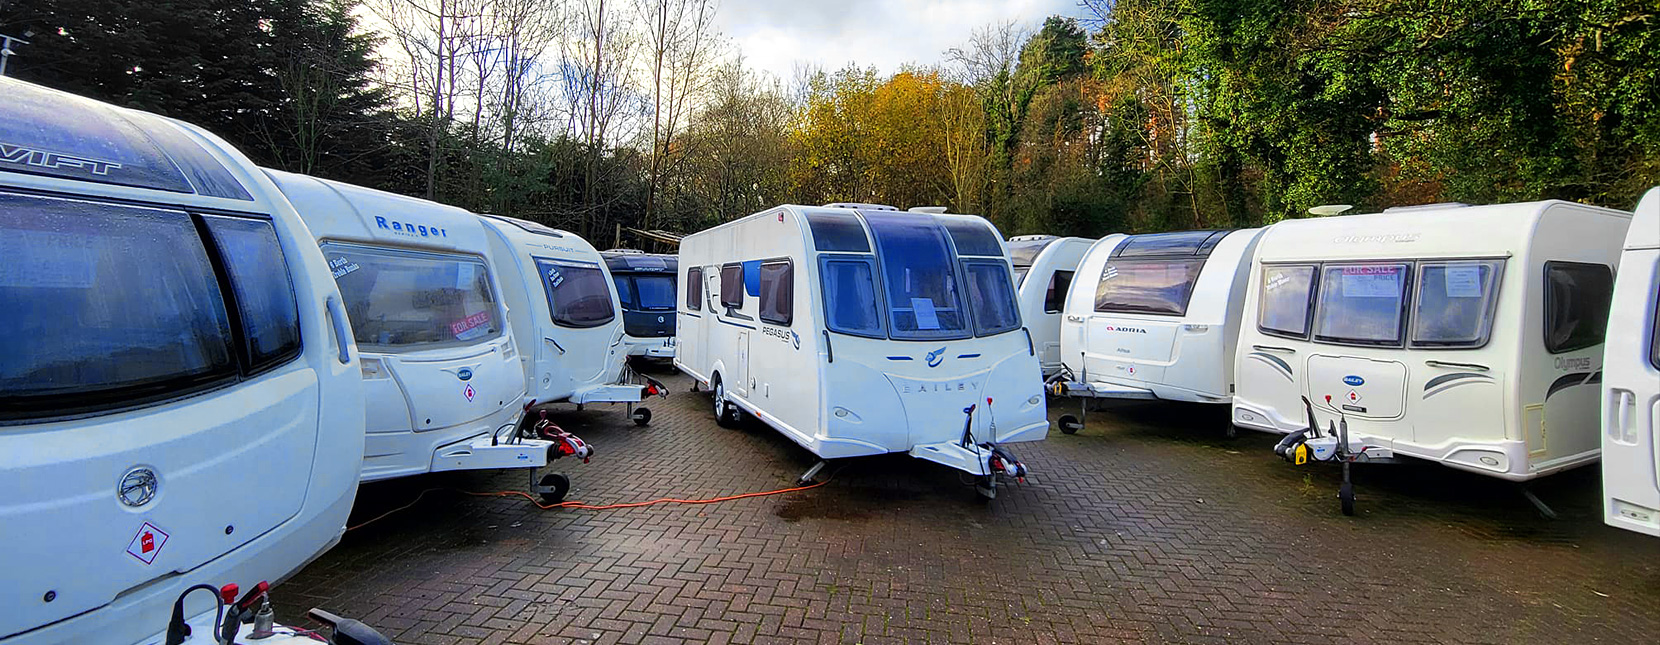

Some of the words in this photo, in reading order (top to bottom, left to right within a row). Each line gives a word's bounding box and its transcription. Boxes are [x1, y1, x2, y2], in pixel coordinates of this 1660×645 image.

[374, 215, 447, 238] Ranger
[452, 321, 469, 334] FOR
[467, 312, 489, 328] SALE
[1115, 326, 1147, 334] ADRIA
[762, 326, 791, 341] PEGASUS
[1553, 355, 1591, 371] Olympus
[902, 381, 979, 394] BAILEY
